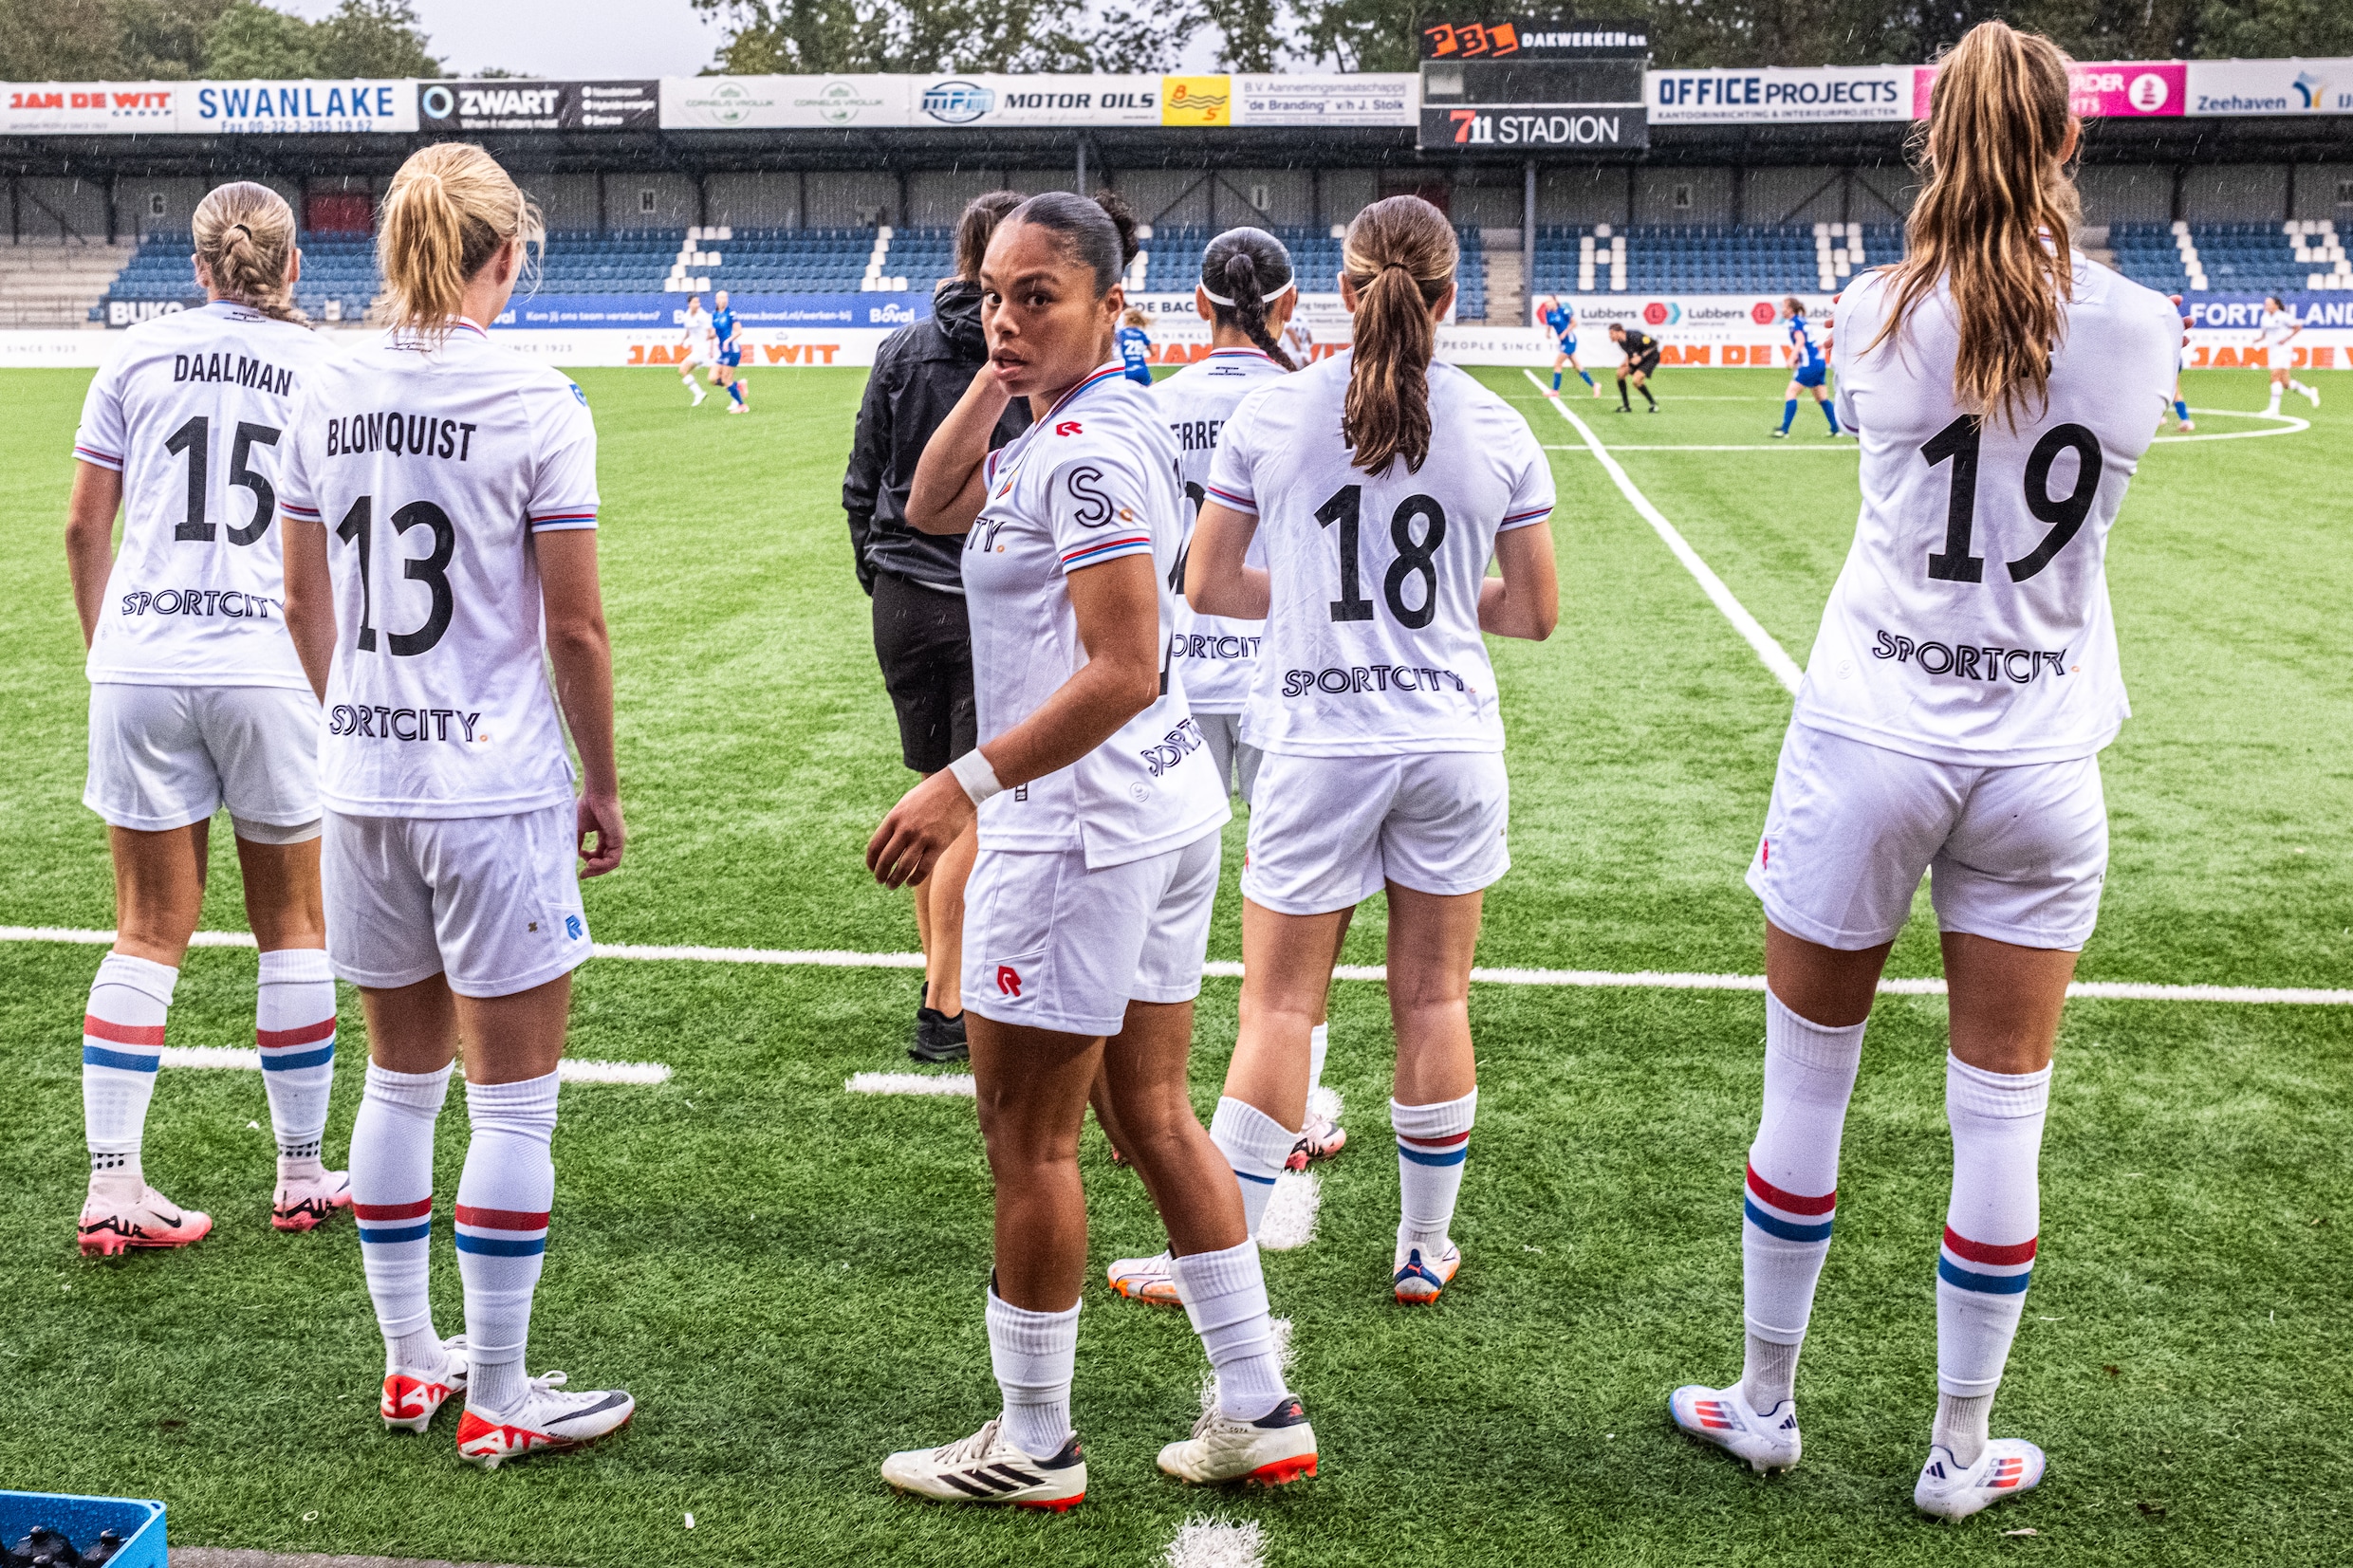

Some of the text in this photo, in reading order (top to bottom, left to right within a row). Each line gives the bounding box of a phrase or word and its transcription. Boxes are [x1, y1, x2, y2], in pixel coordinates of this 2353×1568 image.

[1521, 32, 1627, 47] DAKWERKEN
[1268, 82, 1406, 94] Aannemingsmaatschappij
[1659, 78, 1897, 104] OFFICE PROJECTS
[10, 92, 171, 108] JAN DE WIT
[198, 87, 394, 119] SWANLAKE
[458, 90, 559, 115] ZWART
[1005, 93, 1155, 108] MOTOR OILS
[1373, 100, 1404, 110] Stolk
[2197, 95, 2287, 111] Zeehaven
[1499, 116, 1620, 143] STADION
[870, 306, 915, 323] Boval
[1581, 308, 1637, 319] Lubbers
[1688, 307, 1745, 319] Lubbers
[763, 344, 840, 364] WIT
[1442, 341, 1495, 350] PEOPLE
[1502, 342, 1542, 351] SINCE
[1659, 345, 1711, 364] AN
[1722, 345, 1771, 364] DE
[2190, 347, 2269, 367] JAN
[174, 353, 293, 397] DAALMAN
[164, 415, 282, 546] 15
[1919, 414, 2103, 583] 19
[1313, 484, 1447, 630] 18
[336, 495, 455, 656] 13
